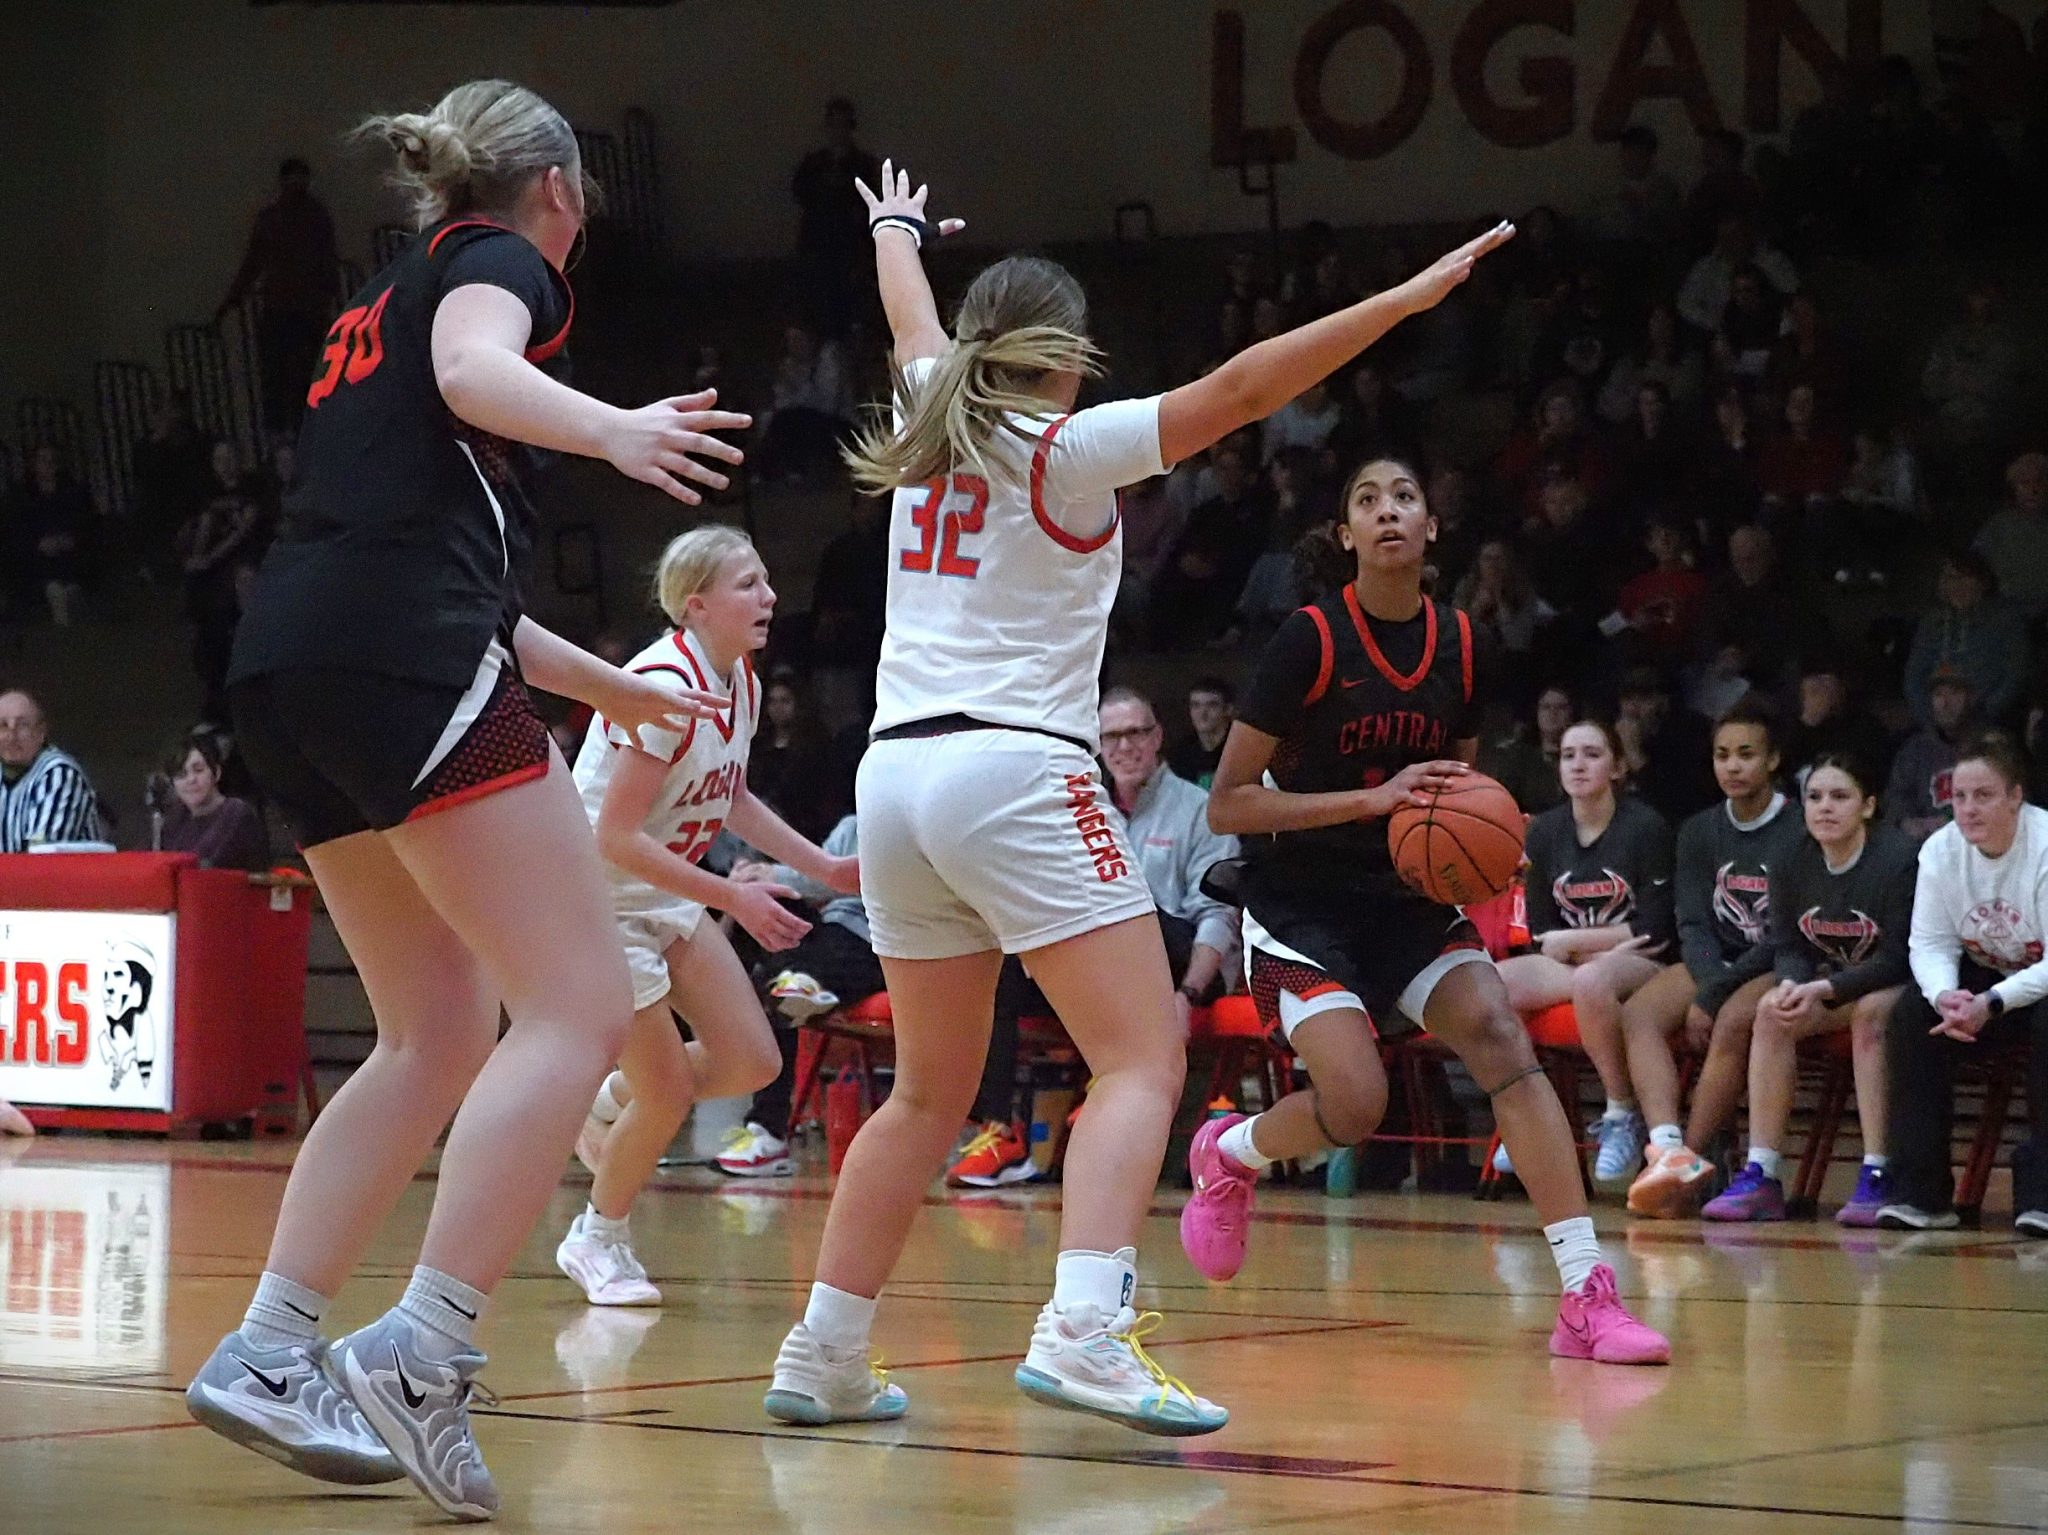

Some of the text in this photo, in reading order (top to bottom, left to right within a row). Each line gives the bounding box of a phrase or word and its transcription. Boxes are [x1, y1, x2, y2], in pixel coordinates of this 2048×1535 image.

[1212, 0, 1883, 166] LOGAN
[306, 281, 396, 410] 30
[899, 471, 990, 579] 32
[1340, 710, 1448, 755] CENTRA
[1064, 771, 1128, 882] RANGERS
